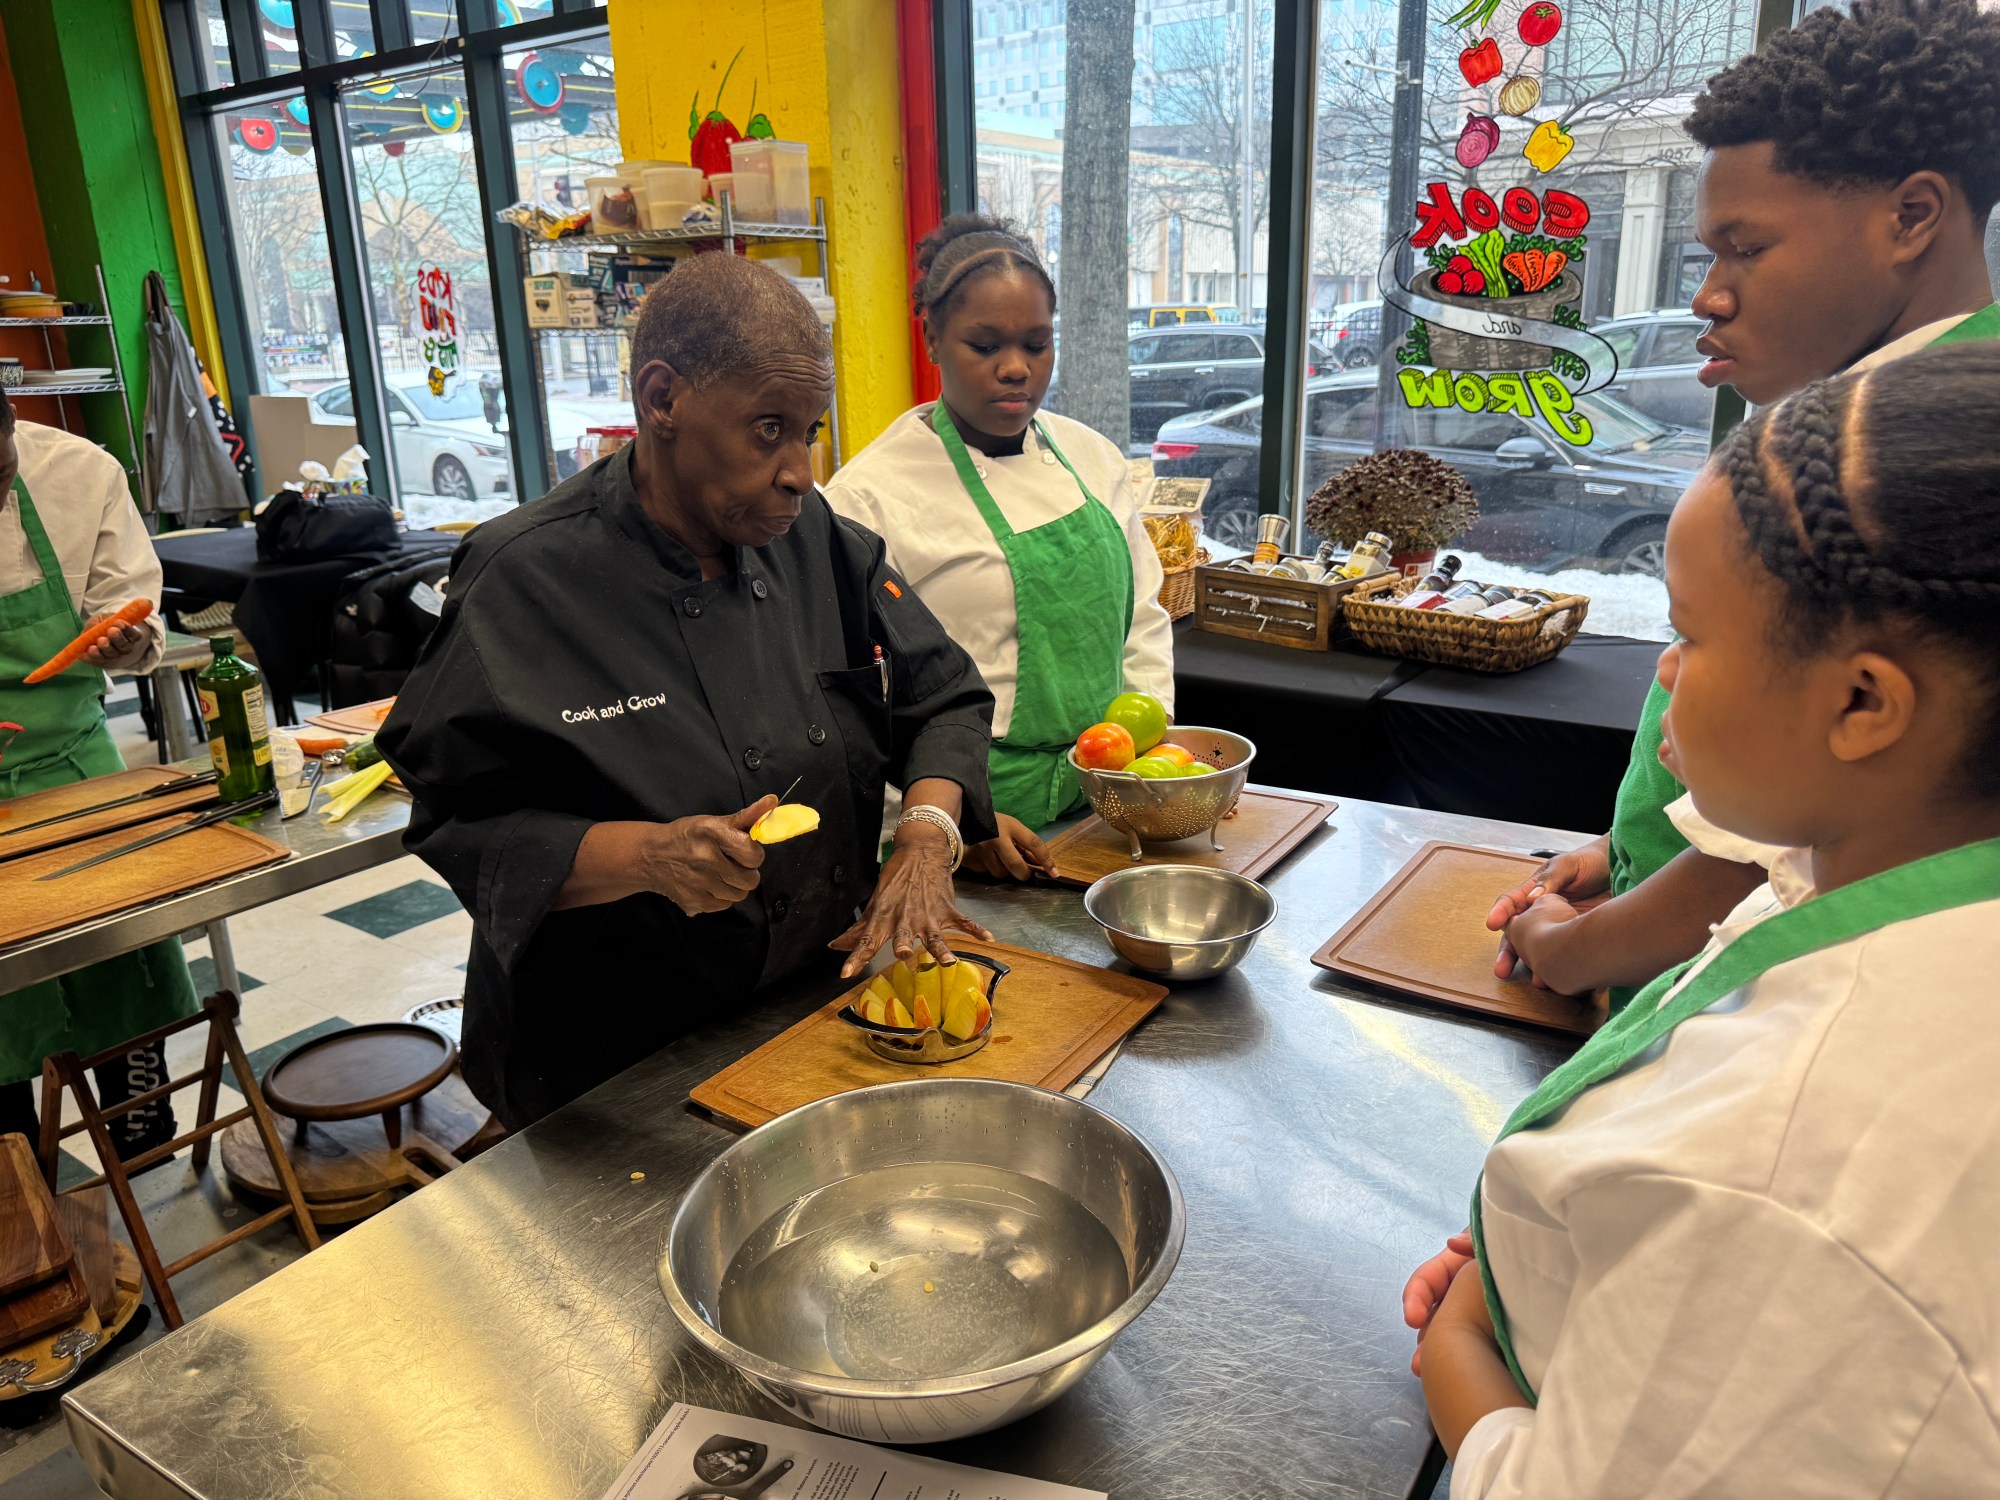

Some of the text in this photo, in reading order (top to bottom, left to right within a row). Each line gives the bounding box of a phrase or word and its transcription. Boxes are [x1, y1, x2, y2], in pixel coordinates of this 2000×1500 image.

[561, 693, 666, 723] Cook and Grow
